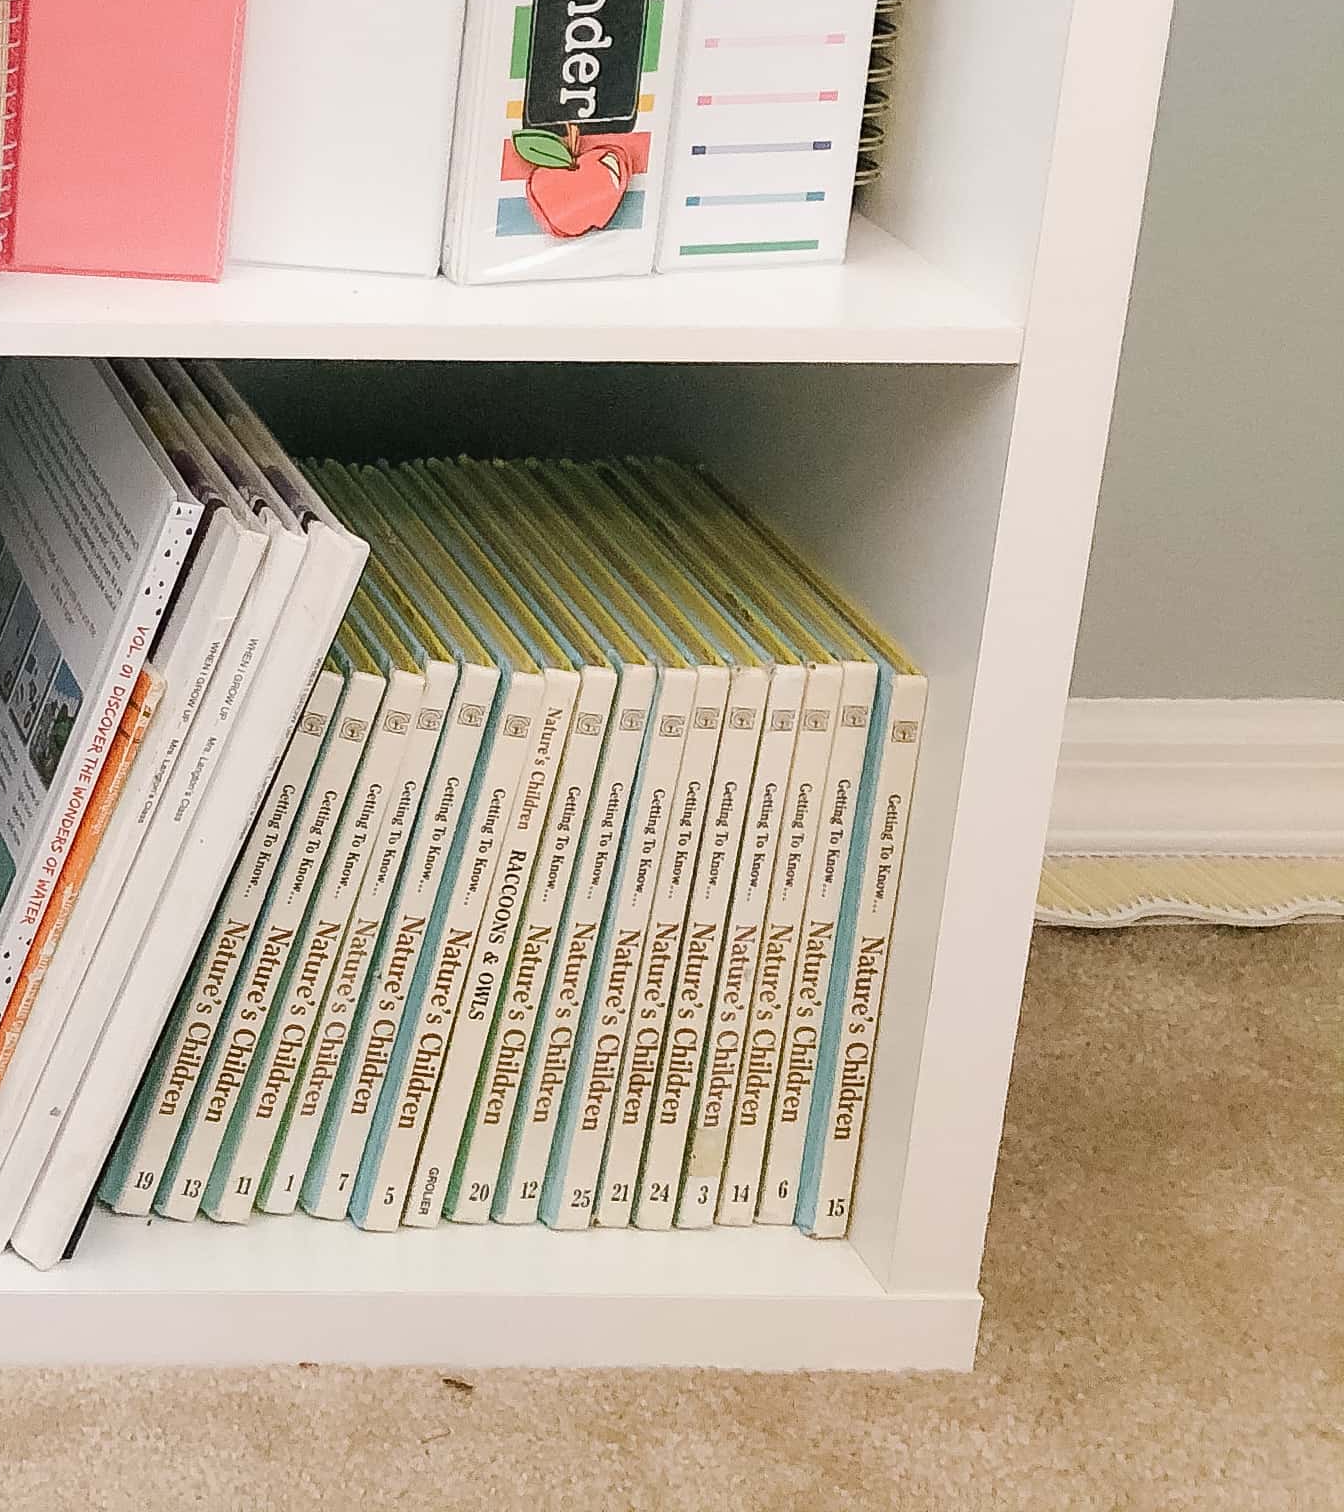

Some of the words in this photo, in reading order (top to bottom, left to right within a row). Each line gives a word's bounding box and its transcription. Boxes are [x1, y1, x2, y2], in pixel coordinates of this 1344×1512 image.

[116, 665, 135, 680] 01
[124, 625, 152, 660] VOL.
[86, 685, 125, 756] DISCOVER
[76, 757, 98, 784] THE
[50, 786, 91, 853] WONDERS
[19, 879, 52, 926] WATER
[488, 849, 527, 944] RACCOONS
[195, 919, 248, 1016] Nature's
[240, 926, 293, 1022] Nature's
[289, 919, 341, 1017] Nature's
[467, 971, 494, 1021] OWLS
[482, 951, 498, 965] &
[848, 936, 886, 1034] Nature's
[158, 1020, 214, 1117] Children
[205, 1027, 259, 1123] Children
[256, 1022, 308, 1119] Children
[833, 1041, 870, 1140] Children
